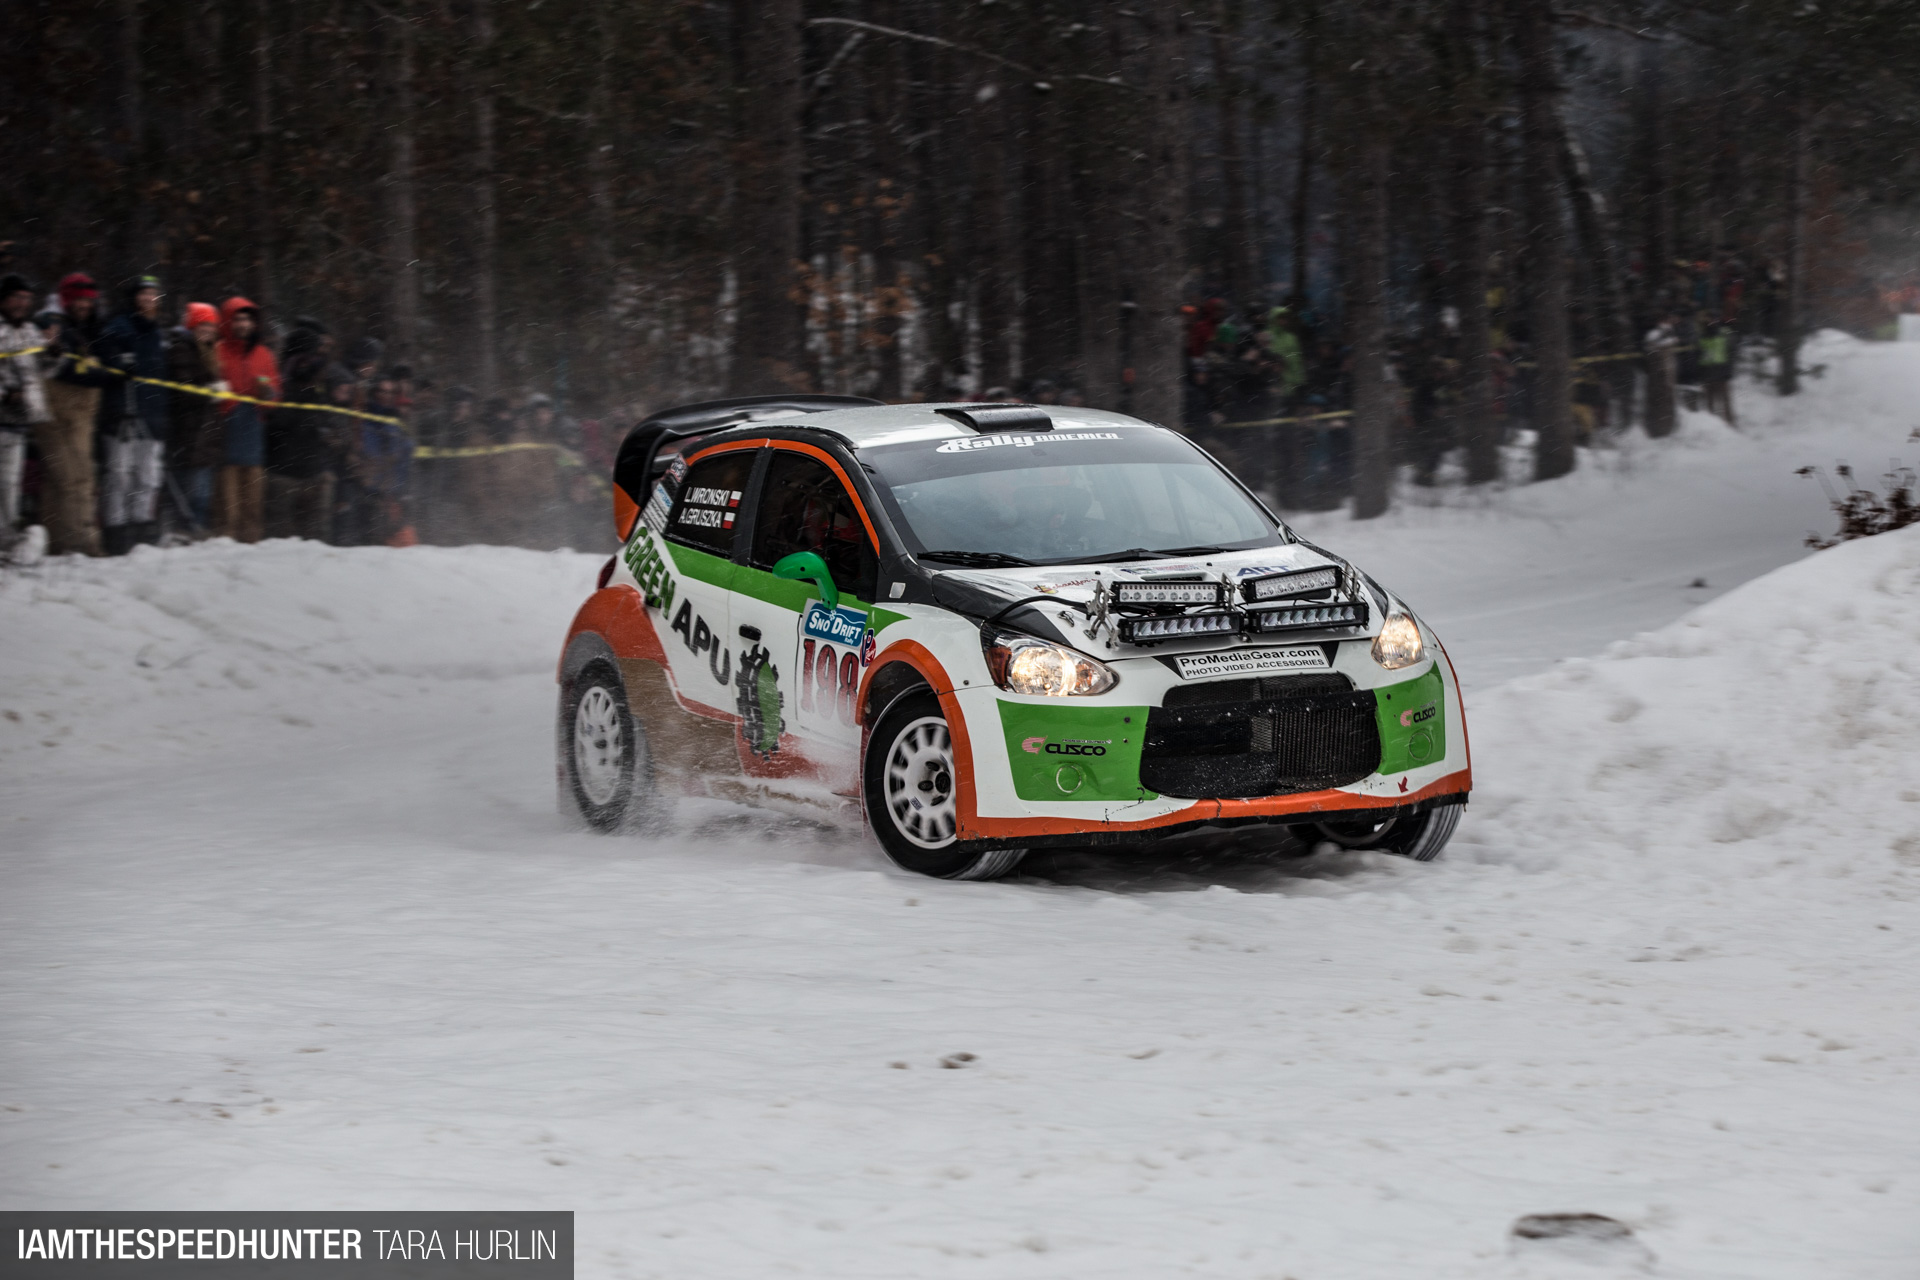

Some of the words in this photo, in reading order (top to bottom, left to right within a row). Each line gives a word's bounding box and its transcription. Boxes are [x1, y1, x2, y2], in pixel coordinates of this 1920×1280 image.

[937, 435, 1034, 453] Rally
[624, 527, 676, 620] GREEN
[831, 617, 862, 640] DRIFT
[671, 597, 731, 686] APU
[1180, 650, 1321, 667] ProMediaGear.com
[1186, 667, 1221, 677] PHOTO
[1222, 663, 1254, 672] VIDEO
[1256, 658, 1325, 669] ACCESSORIES
[801, 638, 859, 728] 198
[1045, 743, 1106, 756] CUSCO
